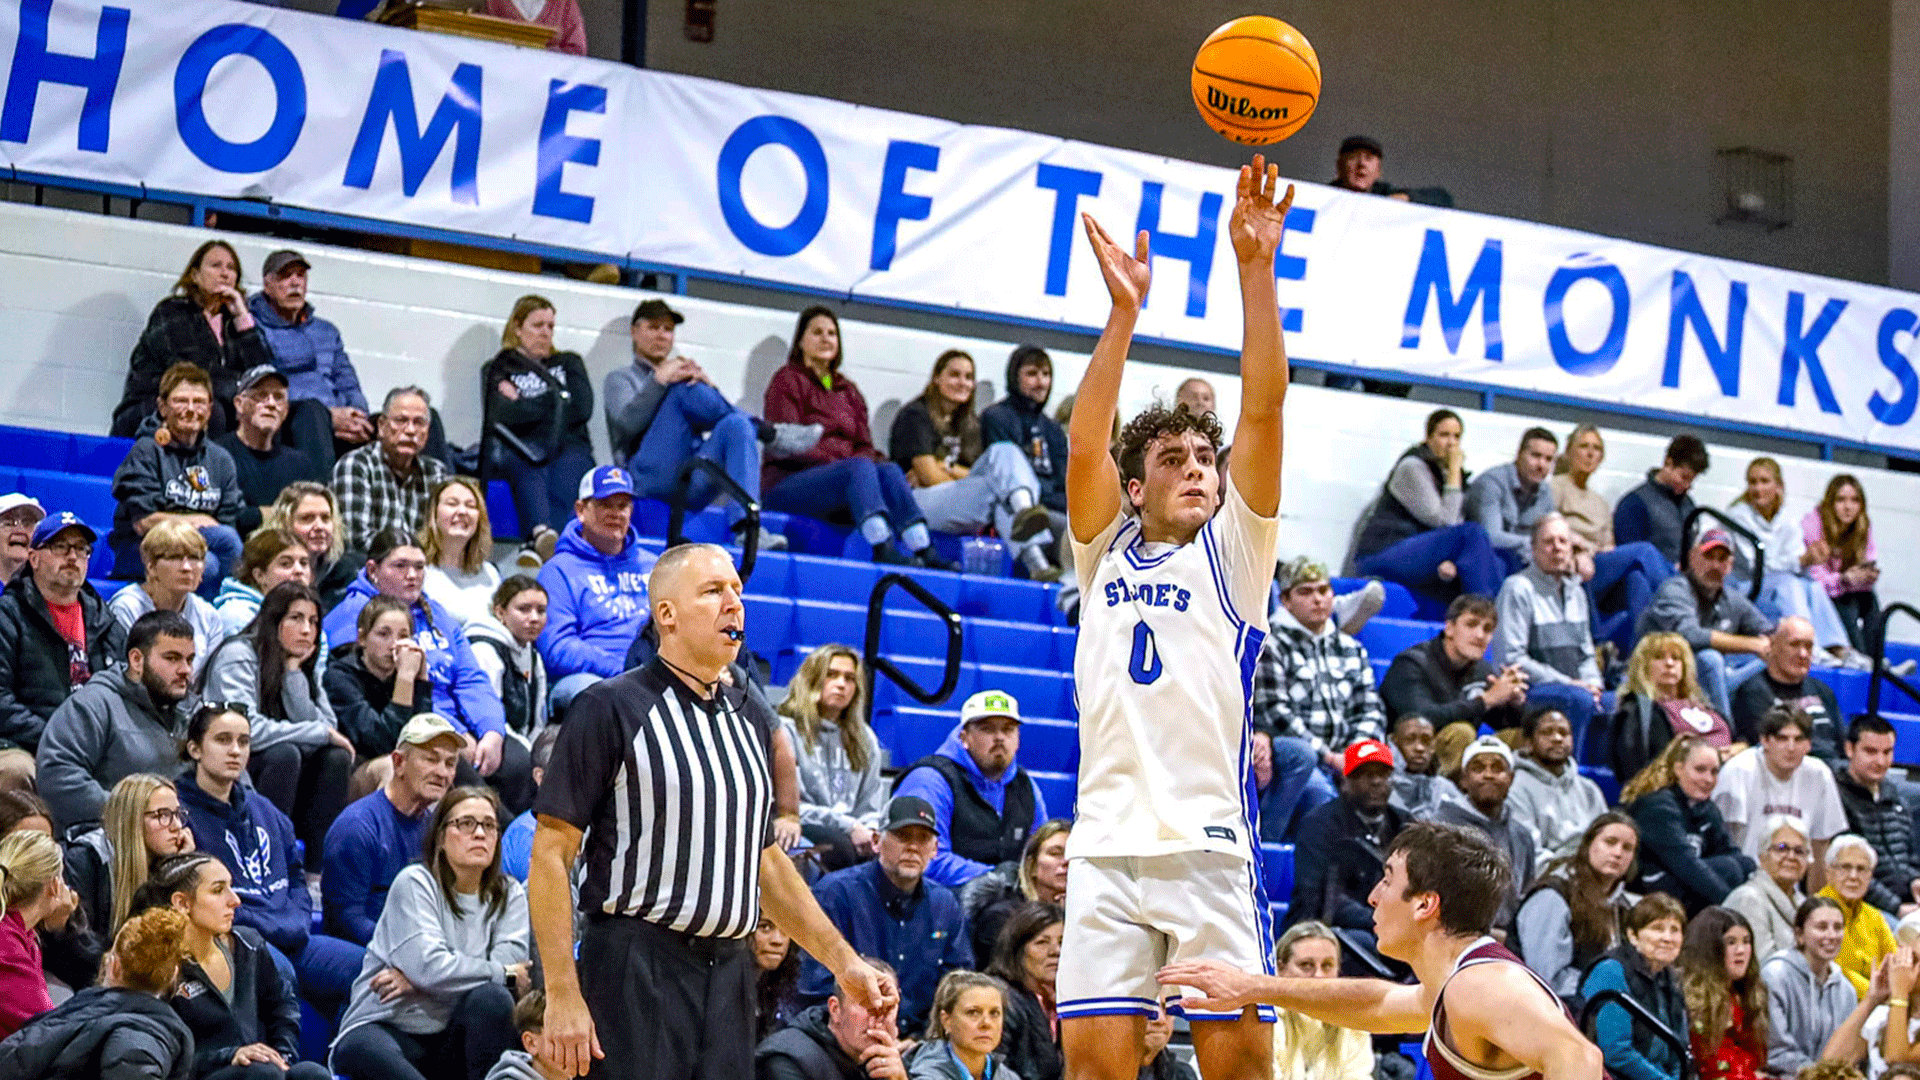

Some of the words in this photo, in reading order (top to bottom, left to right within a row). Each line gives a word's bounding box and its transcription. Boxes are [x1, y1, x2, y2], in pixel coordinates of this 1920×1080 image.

[1207, 84, 1289, 120] Wilson
[0, 0, 608, 225] HOME
[716, 113, 942, 271] OF
[1035, 161, 1317, 334] THE
[1399, 228, 1920, 427] MONKS
[1128, 619, 1163, 686] 0
